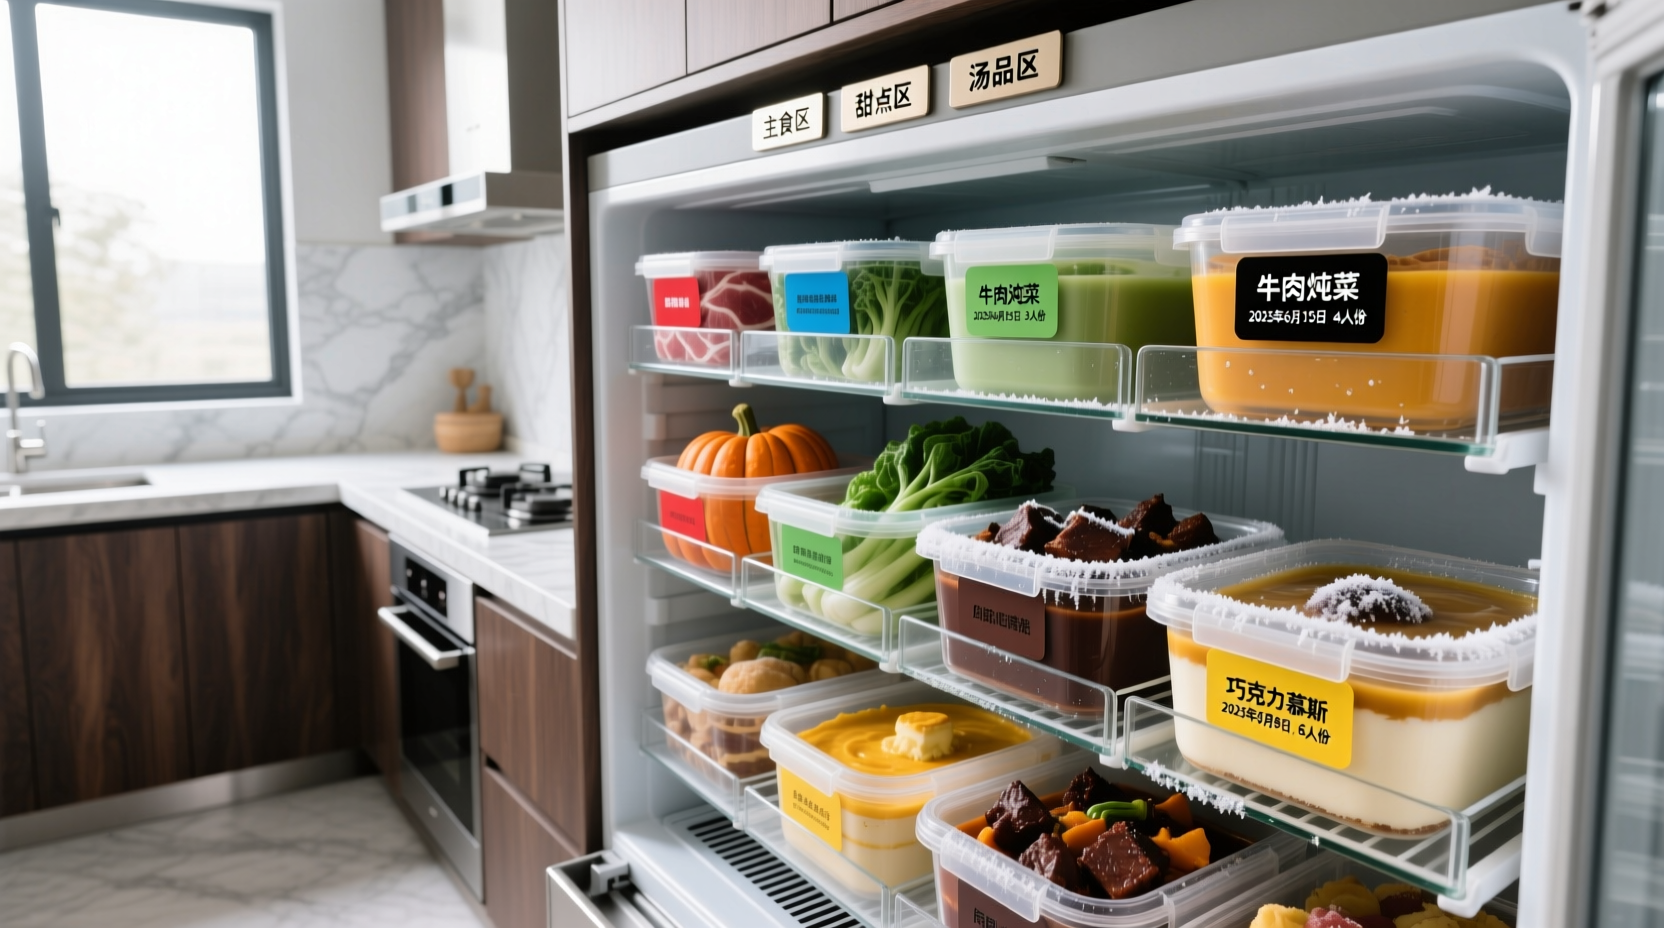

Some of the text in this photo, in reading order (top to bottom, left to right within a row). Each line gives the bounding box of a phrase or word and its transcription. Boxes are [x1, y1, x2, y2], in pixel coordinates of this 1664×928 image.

[969, 49, 1039, 92] 汤品区
[855, 81, 912, 119] 甜点区
[763, 107, 810, 139] 主食区
[1256, 271, 1360, 302] 牛肉炖菜
[1226, 676, 1328, 724] 巧克力慕斯
